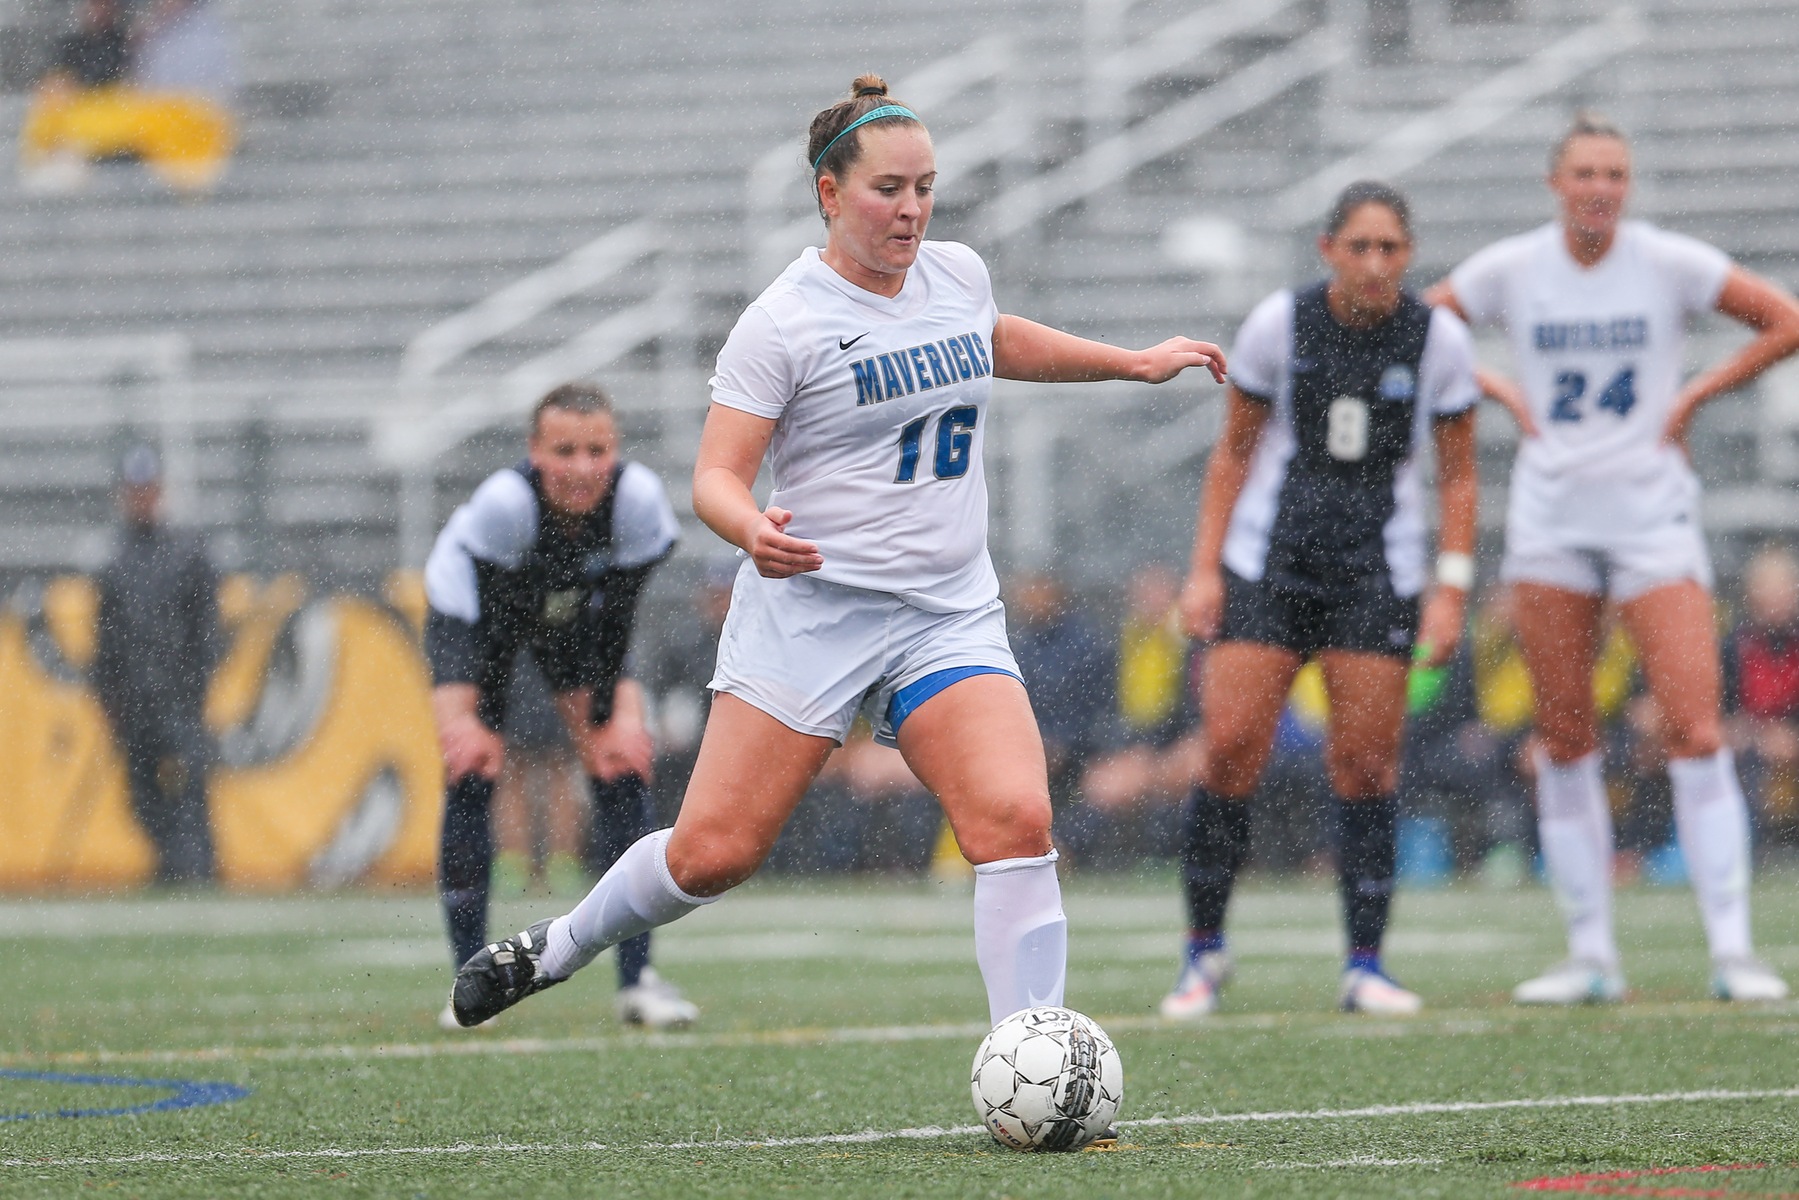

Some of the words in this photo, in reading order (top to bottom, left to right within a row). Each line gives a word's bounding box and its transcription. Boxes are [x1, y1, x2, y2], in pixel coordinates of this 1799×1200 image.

[849, 331, 991, 406] MAVERICKS
[1549, 366, 1637, 423] 24
[893, 405, 978, 484] 16
